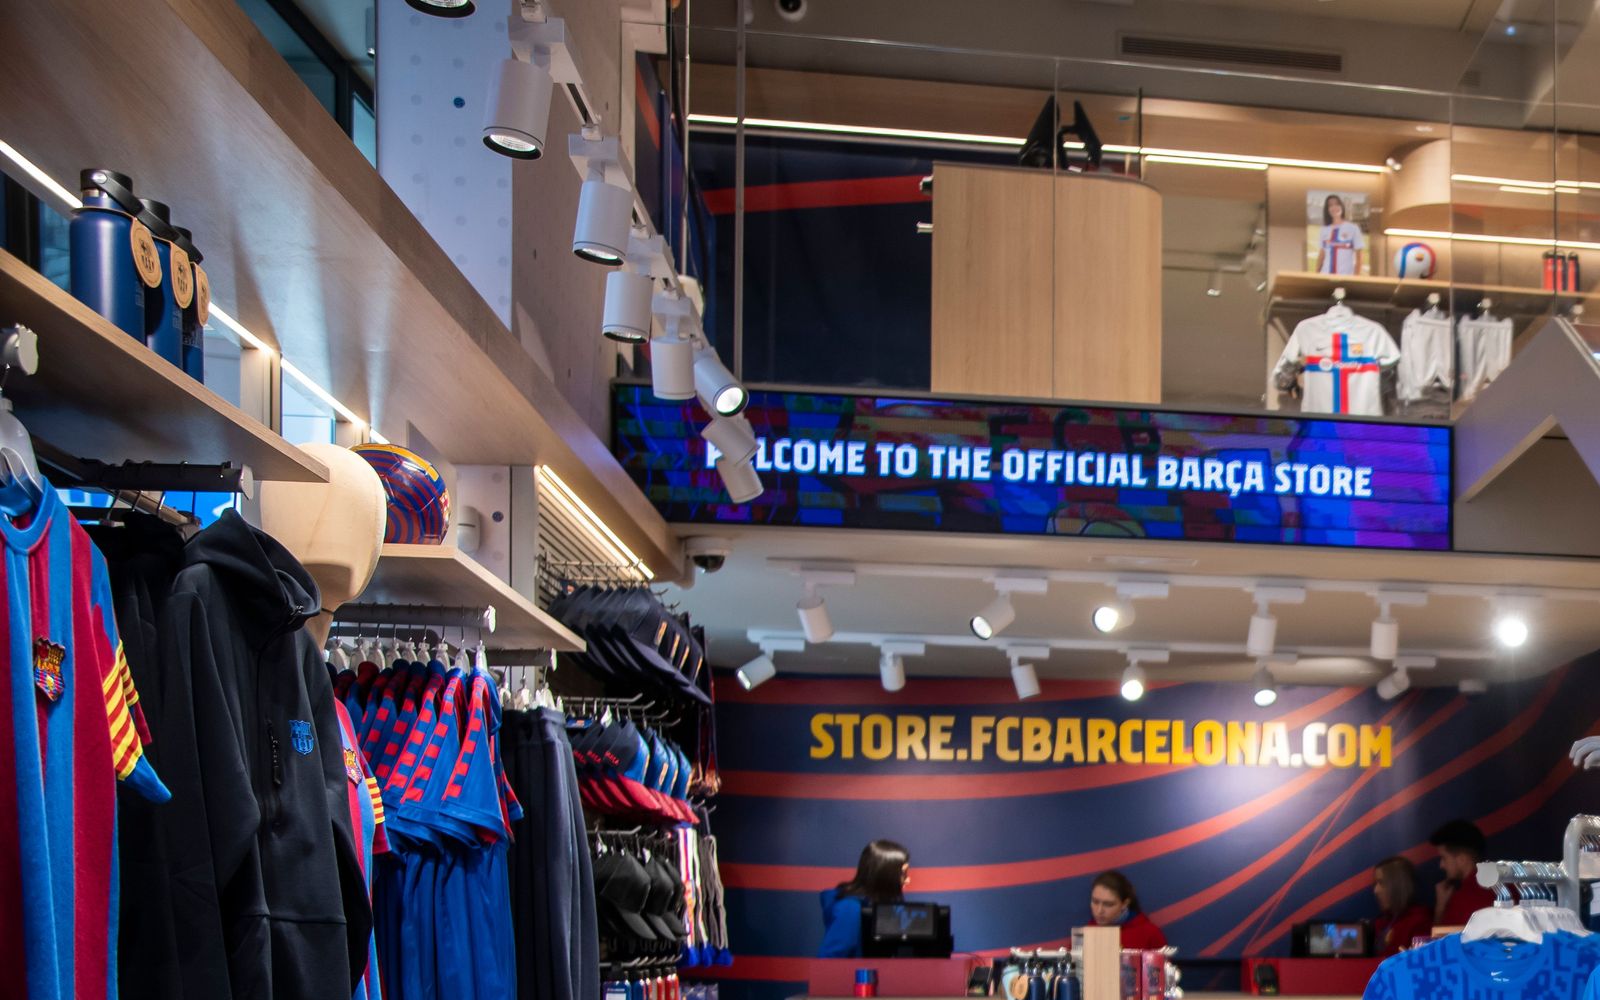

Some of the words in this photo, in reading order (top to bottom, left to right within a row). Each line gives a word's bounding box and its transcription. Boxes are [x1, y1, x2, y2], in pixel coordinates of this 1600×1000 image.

[706, 437, 866, 475] LCOME
[875, 442, 918, 477] TO
[928, 445, 992, 480] THE
[1001, 449, 1148, 486] OFFICIAL
[1156, 456, 1265, 497] BARÇA
[1273, 463, 1372, 497] STORE
[809, 713, 1393, 768] STORE.FCBARCELONA.COM
